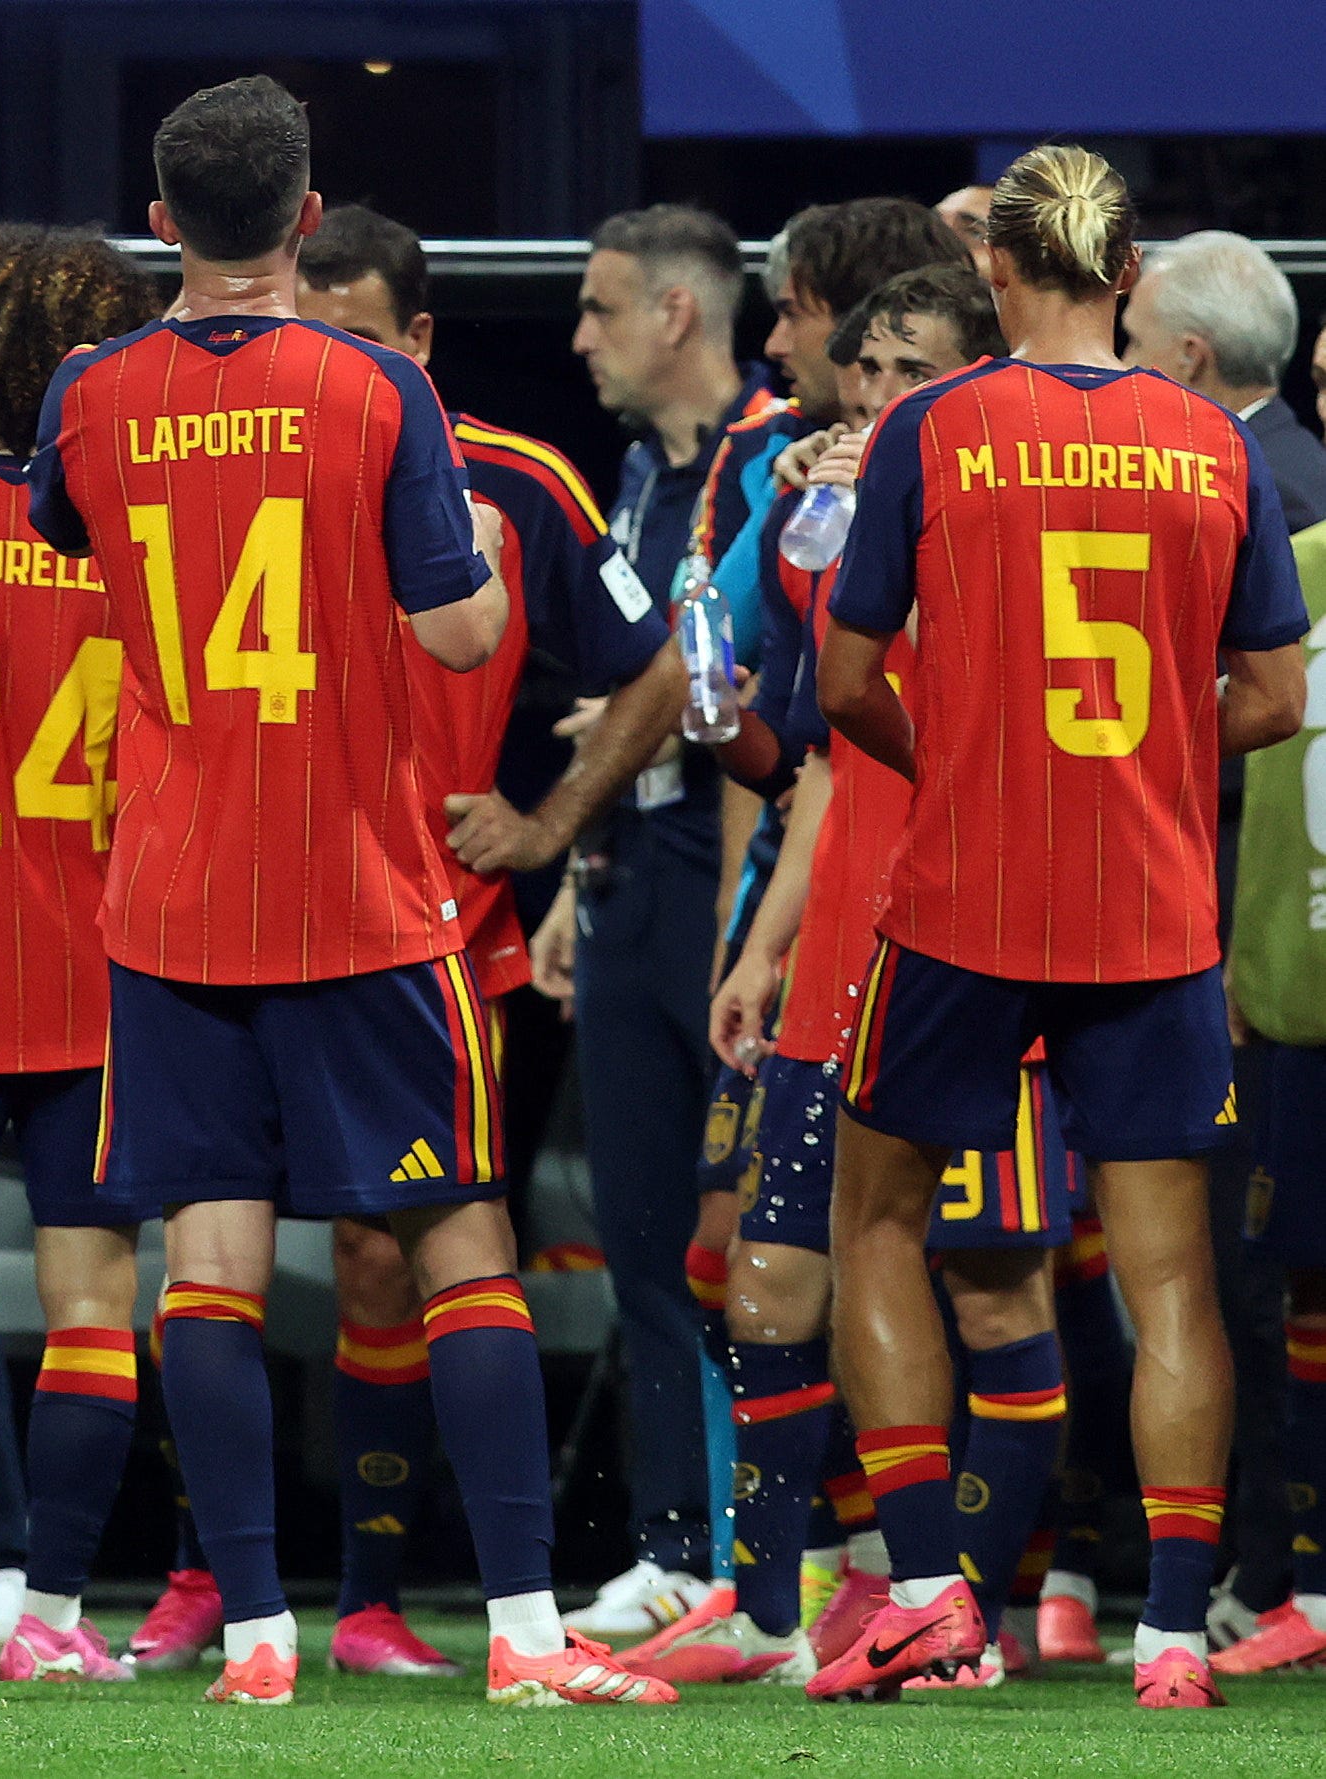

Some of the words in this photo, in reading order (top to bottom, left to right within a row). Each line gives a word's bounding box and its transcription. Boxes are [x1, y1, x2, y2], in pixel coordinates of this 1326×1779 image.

[126, 407, 306, 465] LAPORTE
[956, 444, 1007, 492] M.
[1016, 441, 1220, 499] LLORENTE
[127, 496, 318, 726] 14
[1040, 530, 1153, 758] 5
